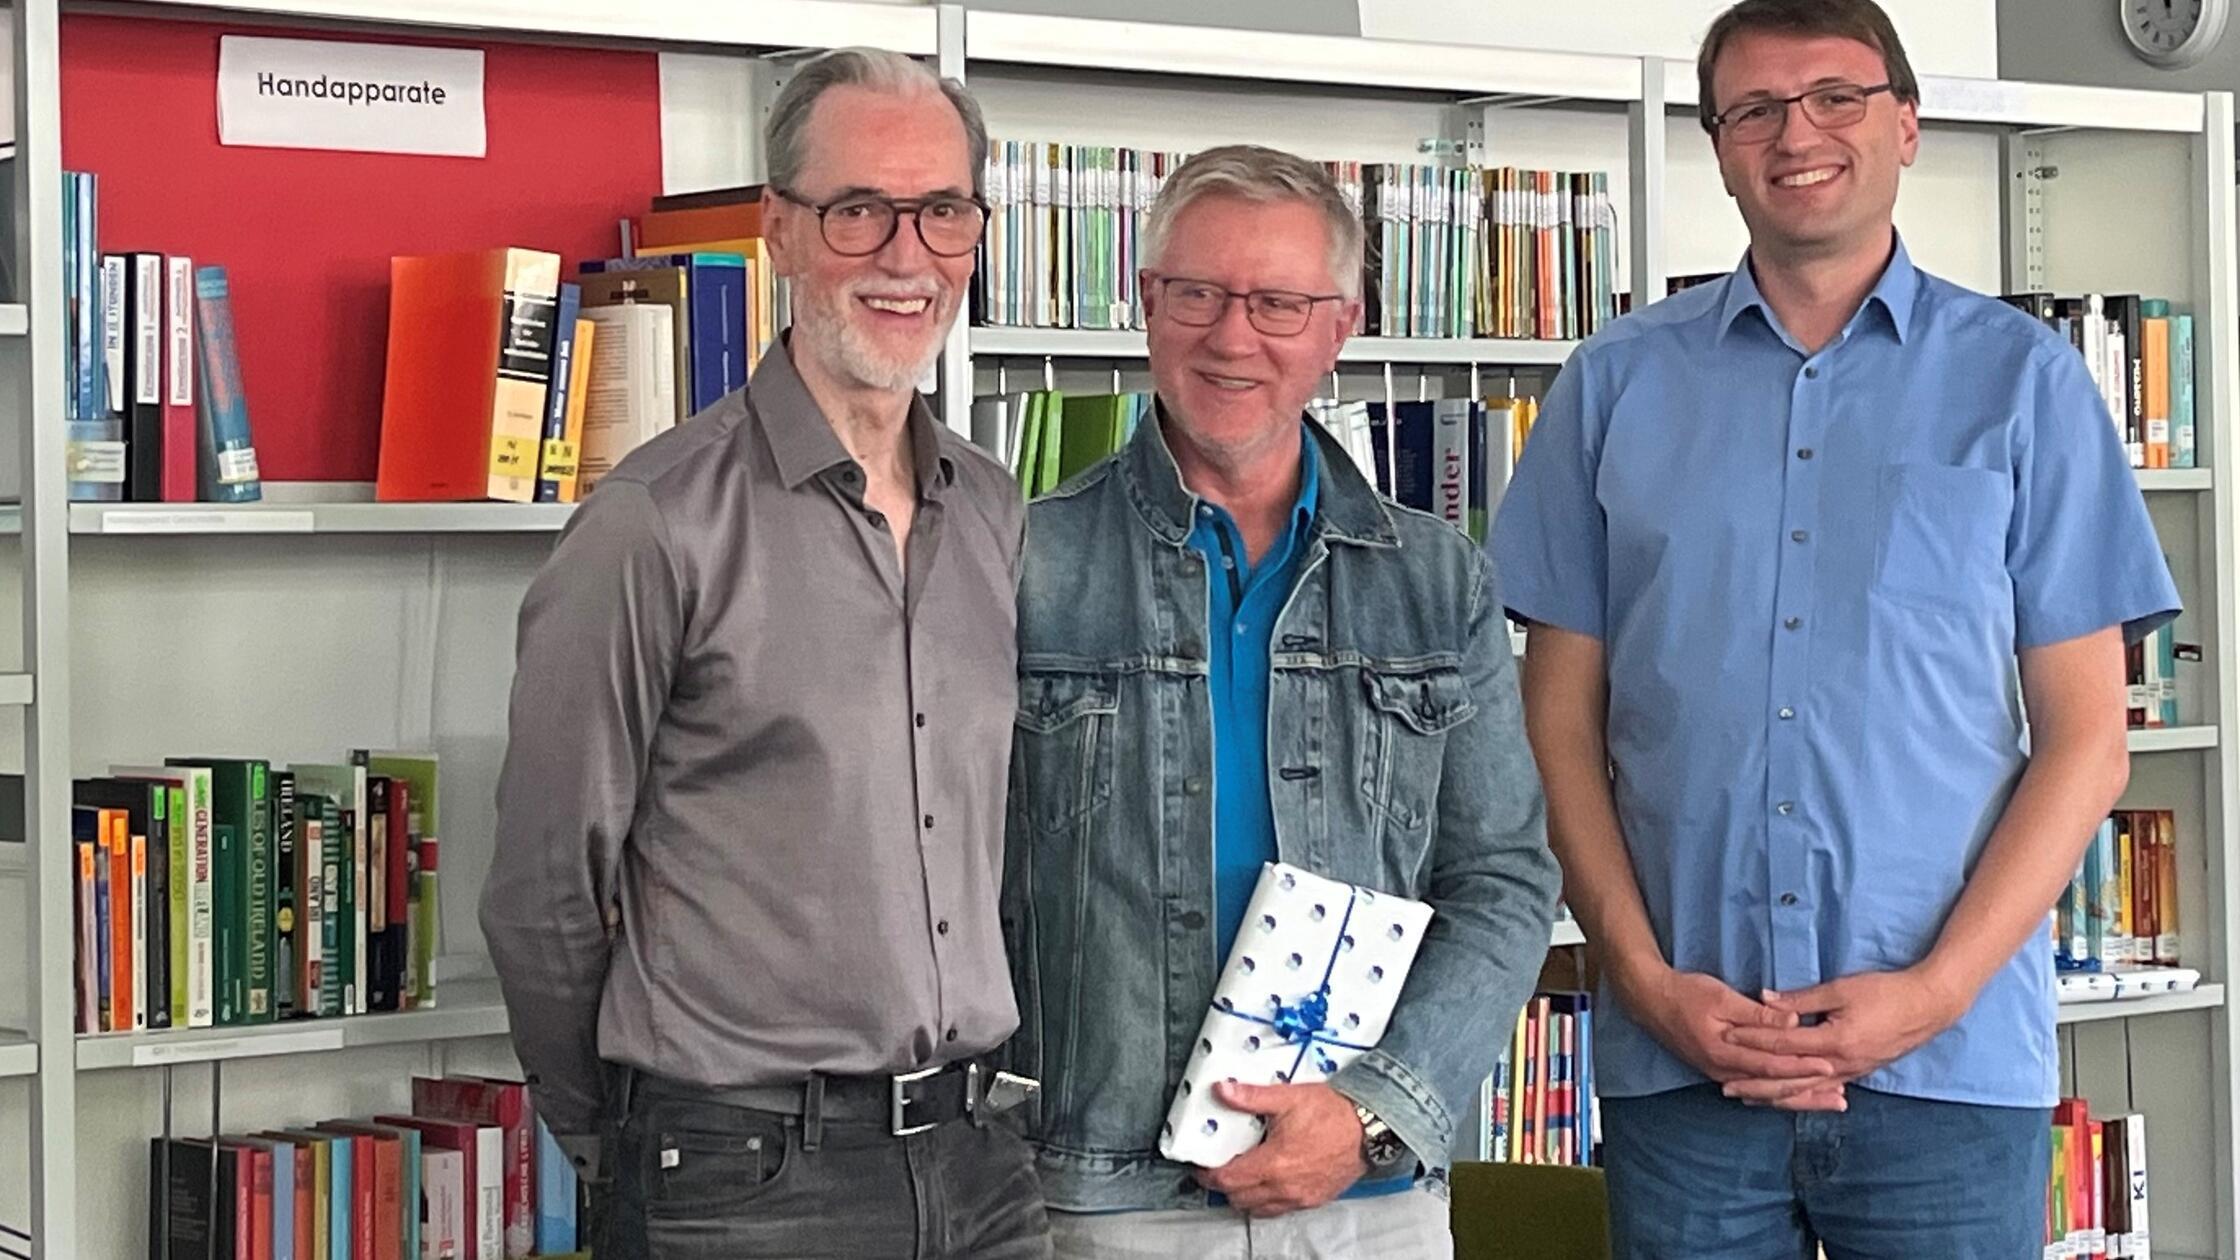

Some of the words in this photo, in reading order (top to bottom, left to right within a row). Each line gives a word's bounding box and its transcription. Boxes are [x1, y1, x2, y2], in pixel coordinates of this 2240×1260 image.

[257, 72, 447, 106] Handapparate
[1441, 448, 1460, 528] nder
[195, 810, 208, 883] GENERATION
[252, 832, 266, 855] OF
[279, 779, 294, 853] IRELAND
[251, 858, 266, 897] OLD
[251, 901, 266, 980] IRELAND
